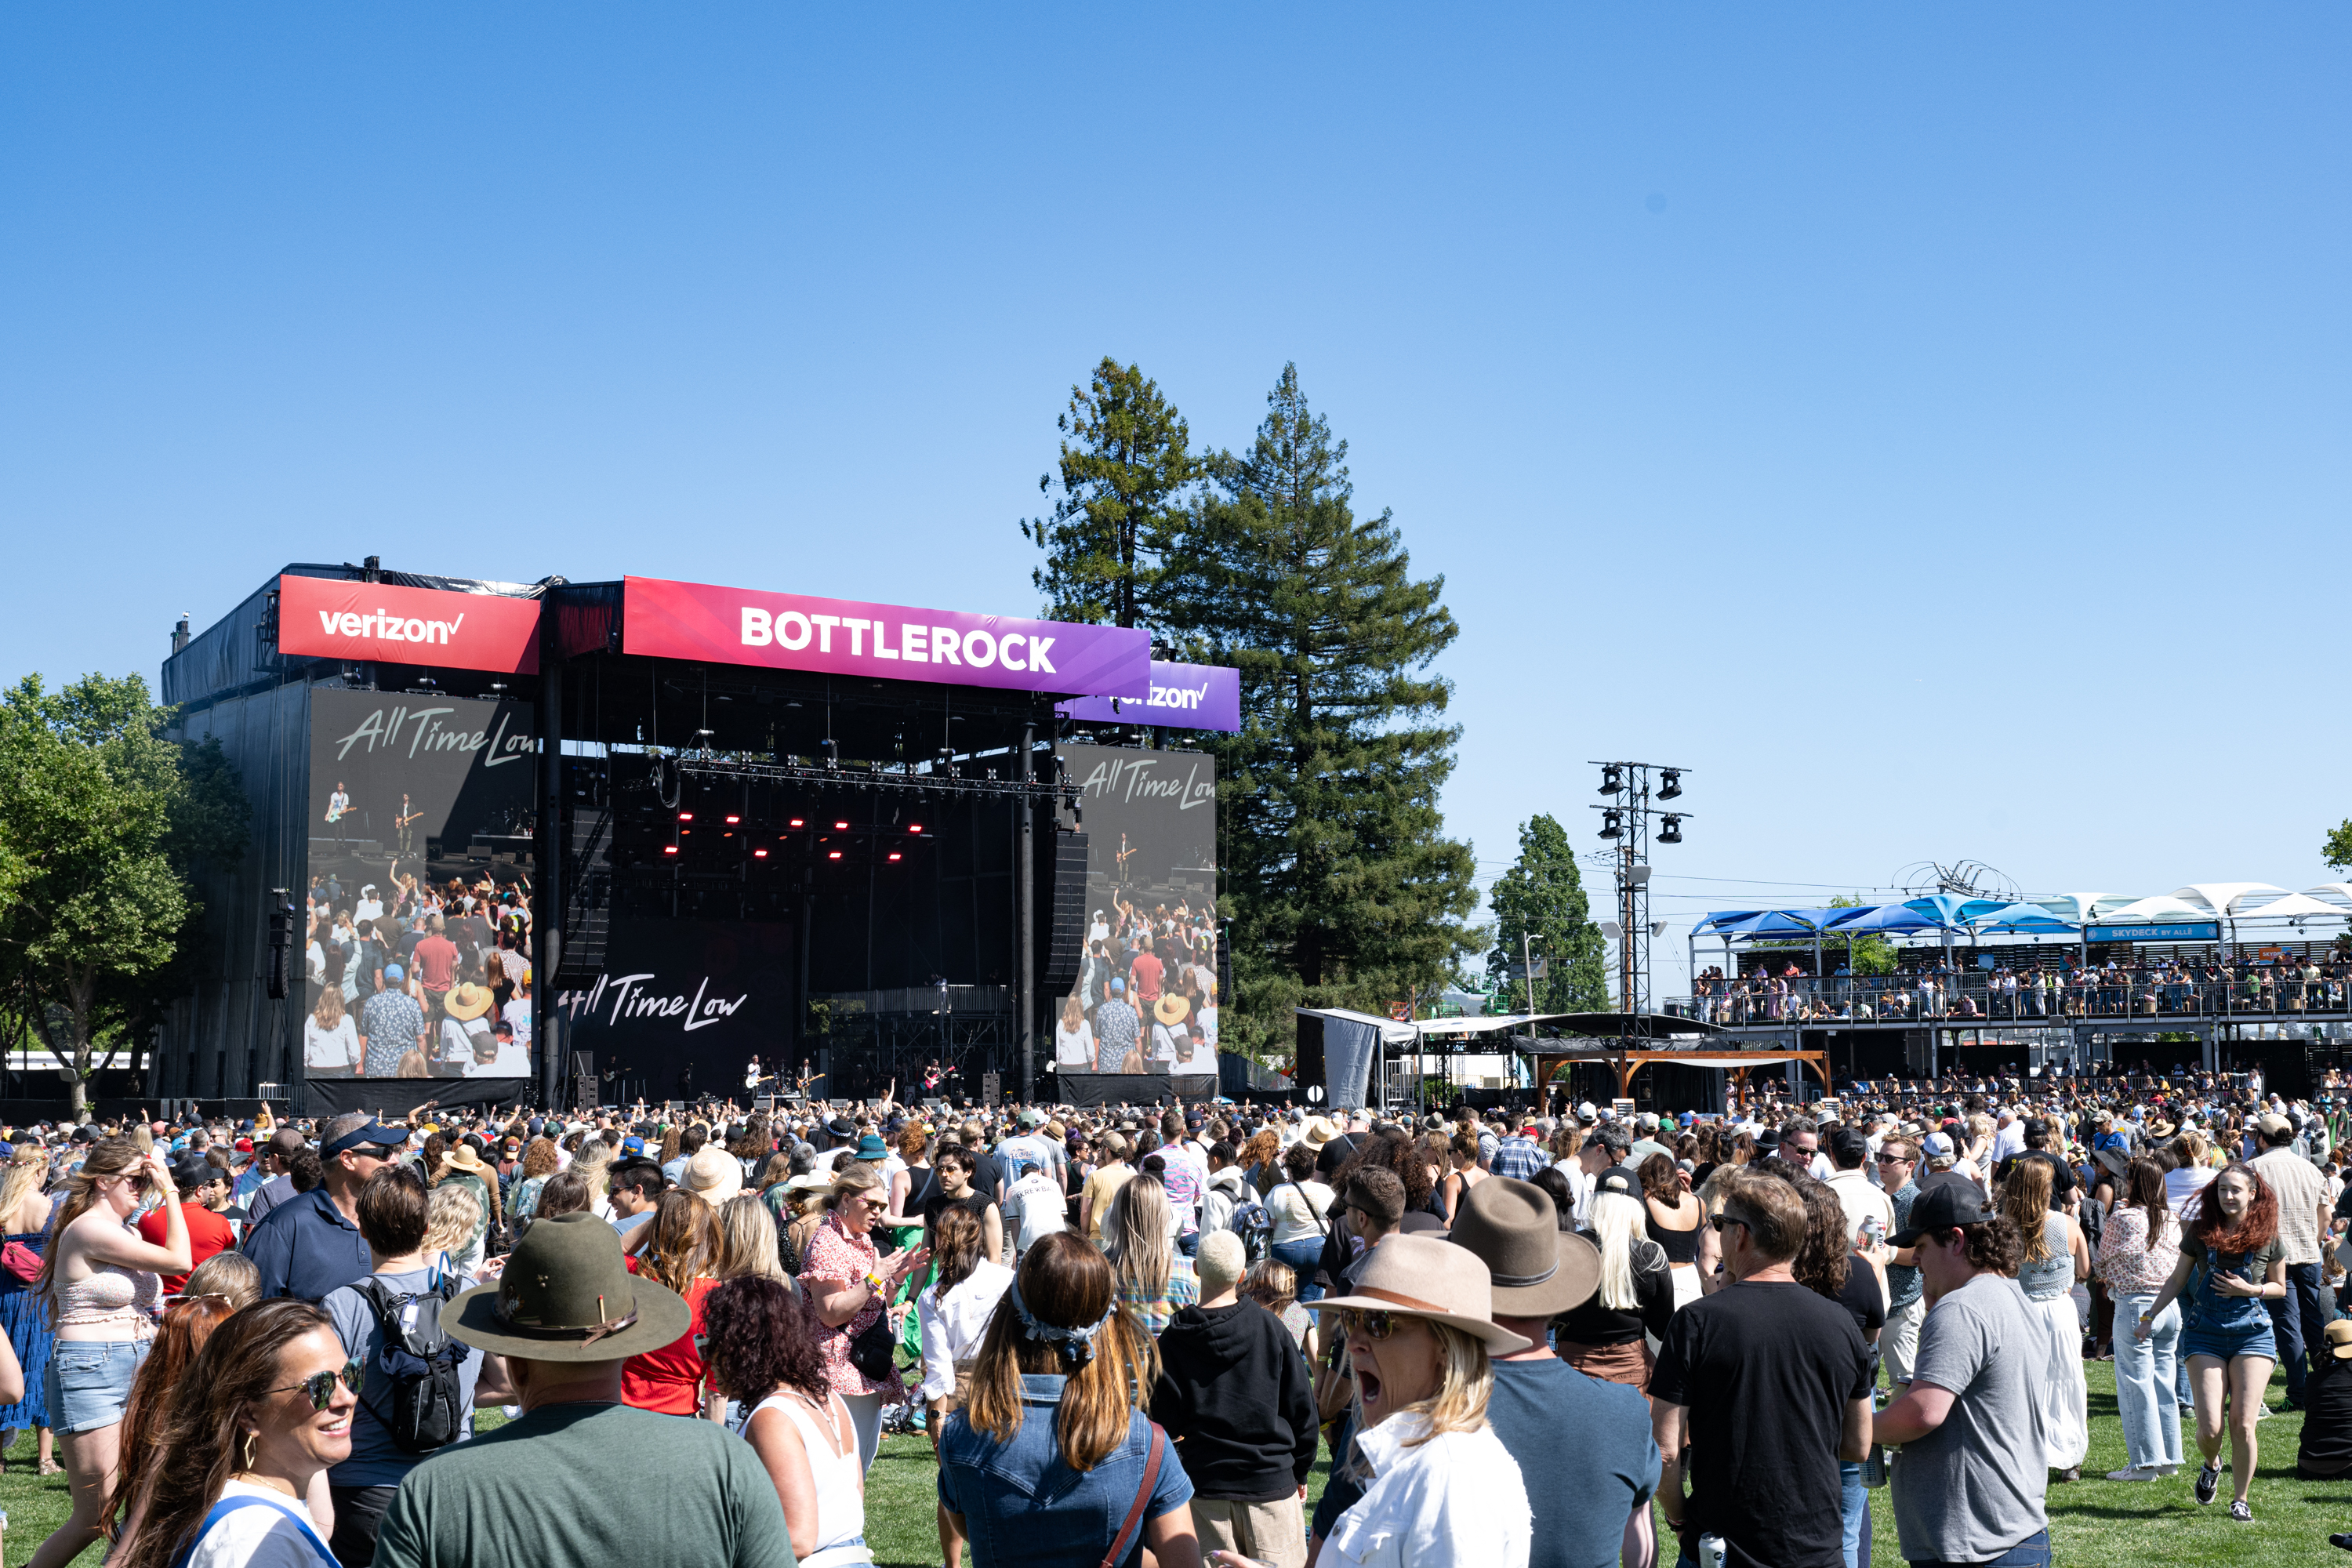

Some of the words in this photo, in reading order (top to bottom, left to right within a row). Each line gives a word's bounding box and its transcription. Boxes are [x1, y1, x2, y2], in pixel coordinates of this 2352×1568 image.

[318, 608, 451, 644] verizon
[741, 606, 1057, 673] BOTTLEROCK
[336, 706, 408, 761] All
[408, 707, 489, 760] Time
[1076, 759, 1123, 802] All
[1124, 760, 1183, 804] Time
[2111, 928, 2158, 938] SKYDECK
[610, 974, 689, 1026] Time
[684, 976, 747, 1031] Low
[1016, 1185, 1054, 1201] SKREWBA
